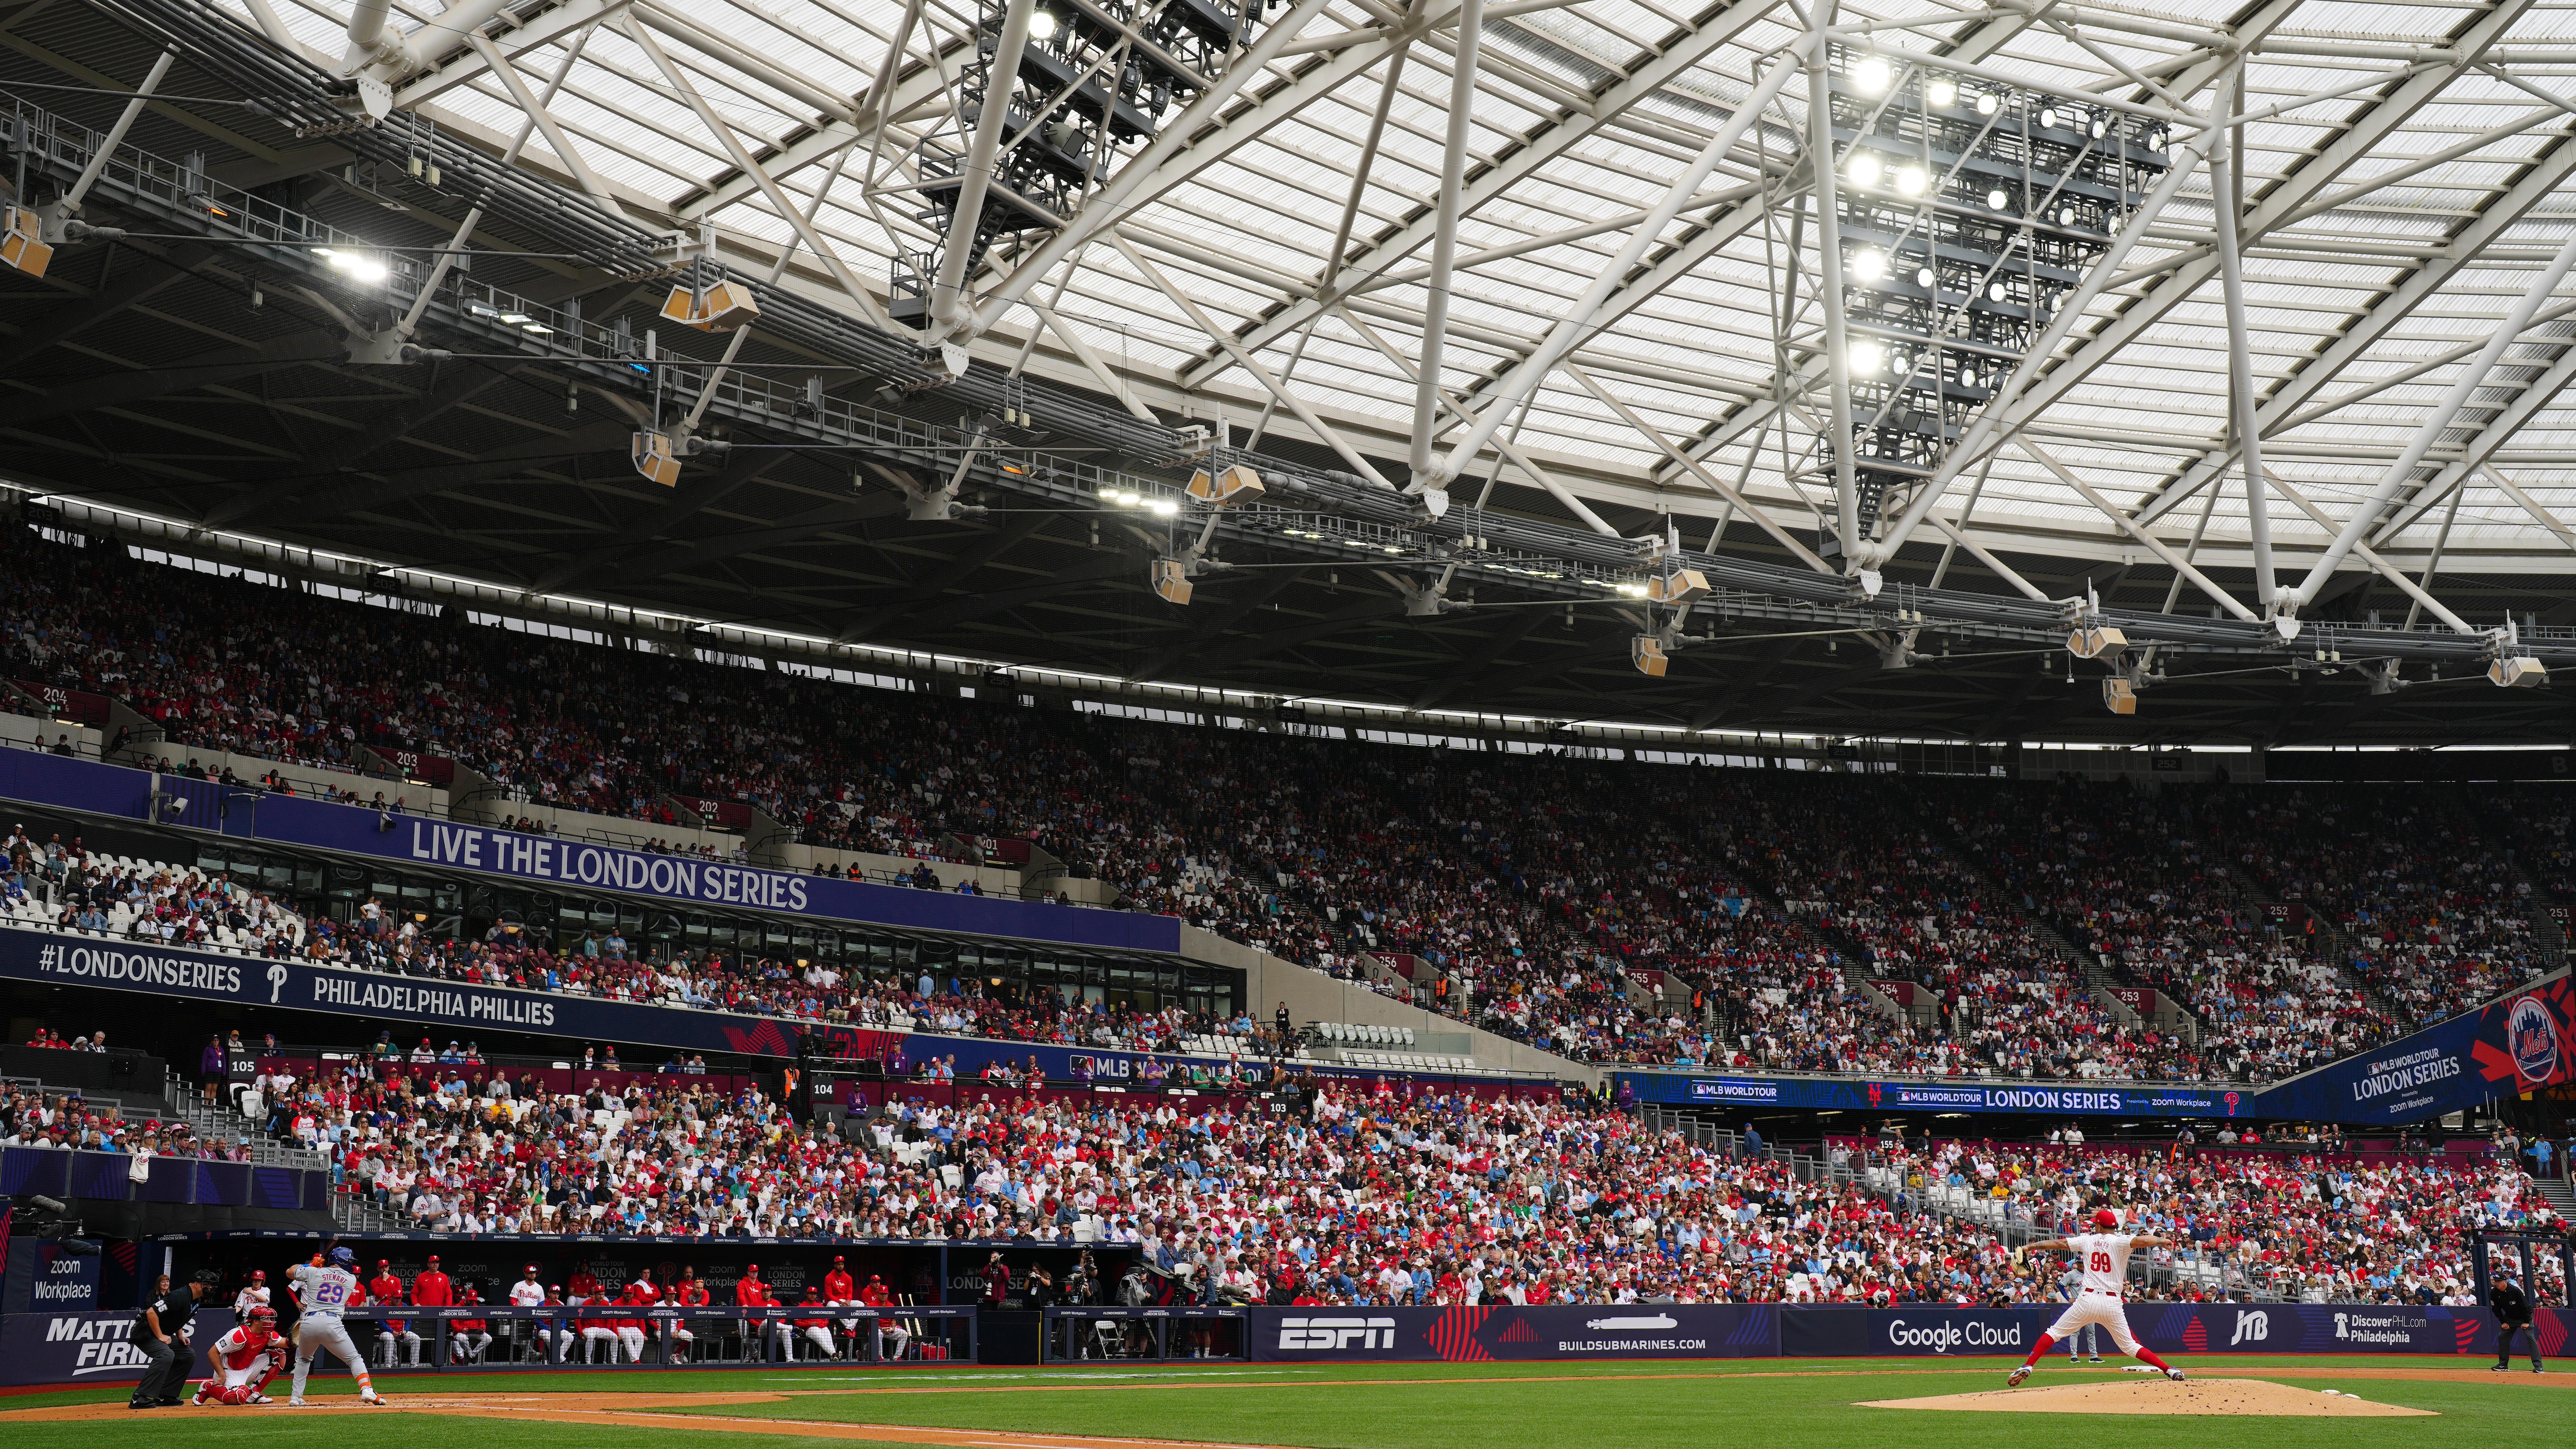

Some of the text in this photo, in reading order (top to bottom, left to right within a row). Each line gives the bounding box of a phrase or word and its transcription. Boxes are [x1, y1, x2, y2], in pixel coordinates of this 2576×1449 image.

[43, 687, 67, 704] 204
[397, 751, 418, 768] 203
[2158, 760, 2176, 768] 252
[2551, 757, 2568, 773] B
[699, 800, 718, 813] 202
[413, 822, 808, 910] LIVE THE LONDON SERIES
[2270, 906, 2288, 916] 252
[2550, 908, 2569, 918] 251
[39, 944, 241, 993] #LONDONSERIES
[1379, 956, 1397, 968] 256
[266, 964, 287, 1003] P
[1630, 972, 1648, 983] 255
[1880, 983, 1898, 995] 254
[2121, 991, 2140, 1002] 253
[314, 977, 555, 1026] PHILADELPHIA PHILLIES
[2520, 1028, 2549, 1059] Mets
[232, 1061, 255, 1072] 105
[1097, 1058, 1129, 1078] MLB
[2353, 1056, 2460, 1101] LONDON SERIES
[814, 1084, 833, 1095] 104
[1986, 1090, 2121, 1110] LONDON SERIES
[2176, 1099, 2211, 1108] Workplace
[2389, 1095, 2434, 1114] zoom Workplace
[1270, 1103, 1286, 1113] 103
[1880, 1140, 1893, 1149] 155
[50, 1259, 80, 1274] zoom
[458, 1264, 487, 1272] zoom
[2091, 1251, 2112, 1273] 99
[322, 1274, 348, 1284] STEWART
[768, 1270, 805, 1279] LONDON
[35, 1281, 92, 1302] Workplace
[771, 1280, 801, 1288] SERIES
[316, 1283, 344, 1304] 29
[519, 1290, 539, 1300] Phillies
[2231, 1310, 2268, 1346] JTB
[2351, 1314, 2427, 1327] DiscoverPHL.com
[46, 1317, 196, 1341] MATTS
[1279, 1318, 1396, 1349] ESPN
[1889, 1319, 2021, 1353] Google Cloud
[2351, 1329, 2410, 1345] Philadelphia
[1559, 1339, 1706, 1351] BUILDSUBMARINES.COM
[76, 1342, 153, 1366] FIRM
